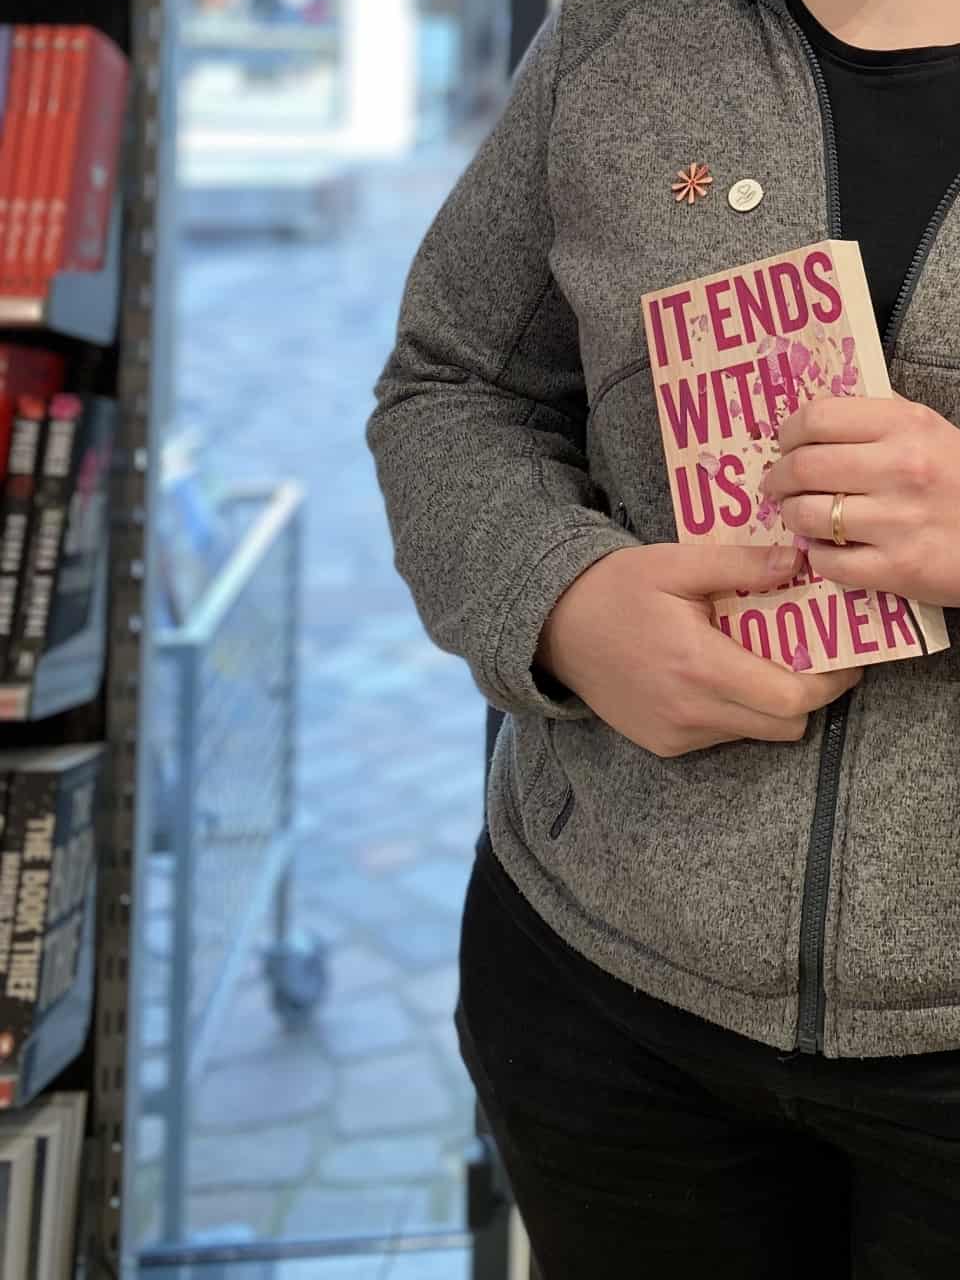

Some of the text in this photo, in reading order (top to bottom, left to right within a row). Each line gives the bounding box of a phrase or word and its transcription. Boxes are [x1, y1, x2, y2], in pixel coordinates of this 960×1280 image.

[648, 251, 843, 368] IT ENDS
[659, 352, 800, 450] WITH
[674, 454, 751, 536] US
[719, 588, 916, 672] OOVER
[6, 812, 56, 1002] THE BOOK THIEF
